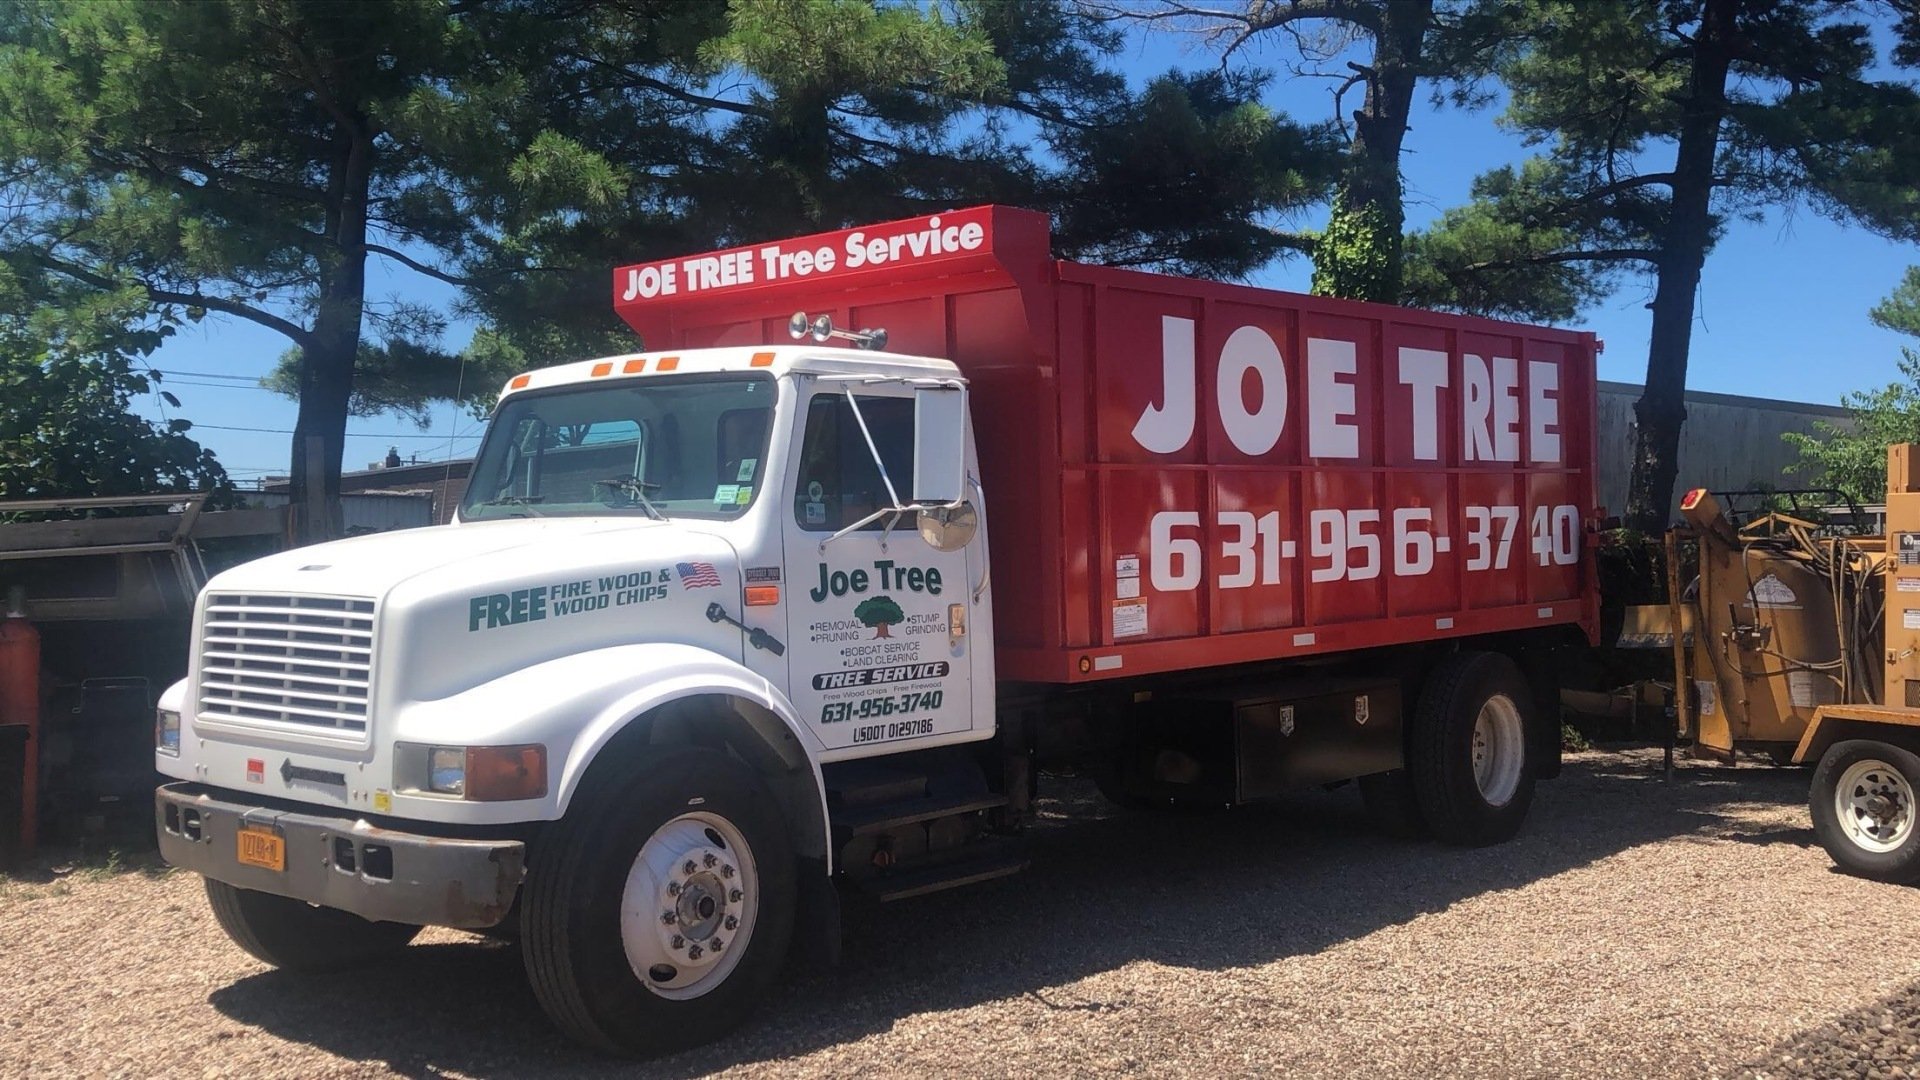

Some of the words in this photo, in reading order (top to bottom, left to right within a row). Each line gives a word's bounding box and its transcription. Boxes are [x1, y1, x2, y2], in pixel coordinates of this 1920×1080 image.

[622, 262, 677, 301] JOE
[684, 250, 754, 291] TREE
[761, 246, 836, 280] Tree
[845, 216, 984, 268] Service
[1131, 315, 1359, 459] JOE
[1398, 346, 1561, 463] TREE
[550, 580, 592, 599] FIRE
[598, 570, 652, 592] WOOD
[658, 568, 672, 583] &
[810, 563, 869, 602] Joe
[874, 560, 942, 594] Tree
[468, 588, 547, 632] FREE
[553, 594, 610, 617] WOOD
[616, 584, 668, 605] CHIPS
[815, 620, 862, 631] REMOVAL
[905, 623, 946, 635] GRINDING
[910, 613, 940, 624] STUMP
[815, 631, 859, 643] PRUNING
[845, 645, 881, 657] BOBCAT
[884, 641, 921, 653] SERVICE
[847, 656, 873, 668] LAND
[875, 652, 919, 665] CLEARING
[820, 671, 867, 689] TREE
[871, 663, 944, 685] SERVICE
[911, 681, 942, 691] Firewood
[843, 690, 865, 698] Wood
[866, 688, 888, 697] Chips
[821, 690, 943, 724] 631-956-3740
[853, 724, 886, 743] USDOT
[888, 718, 934, 738] 01297186
